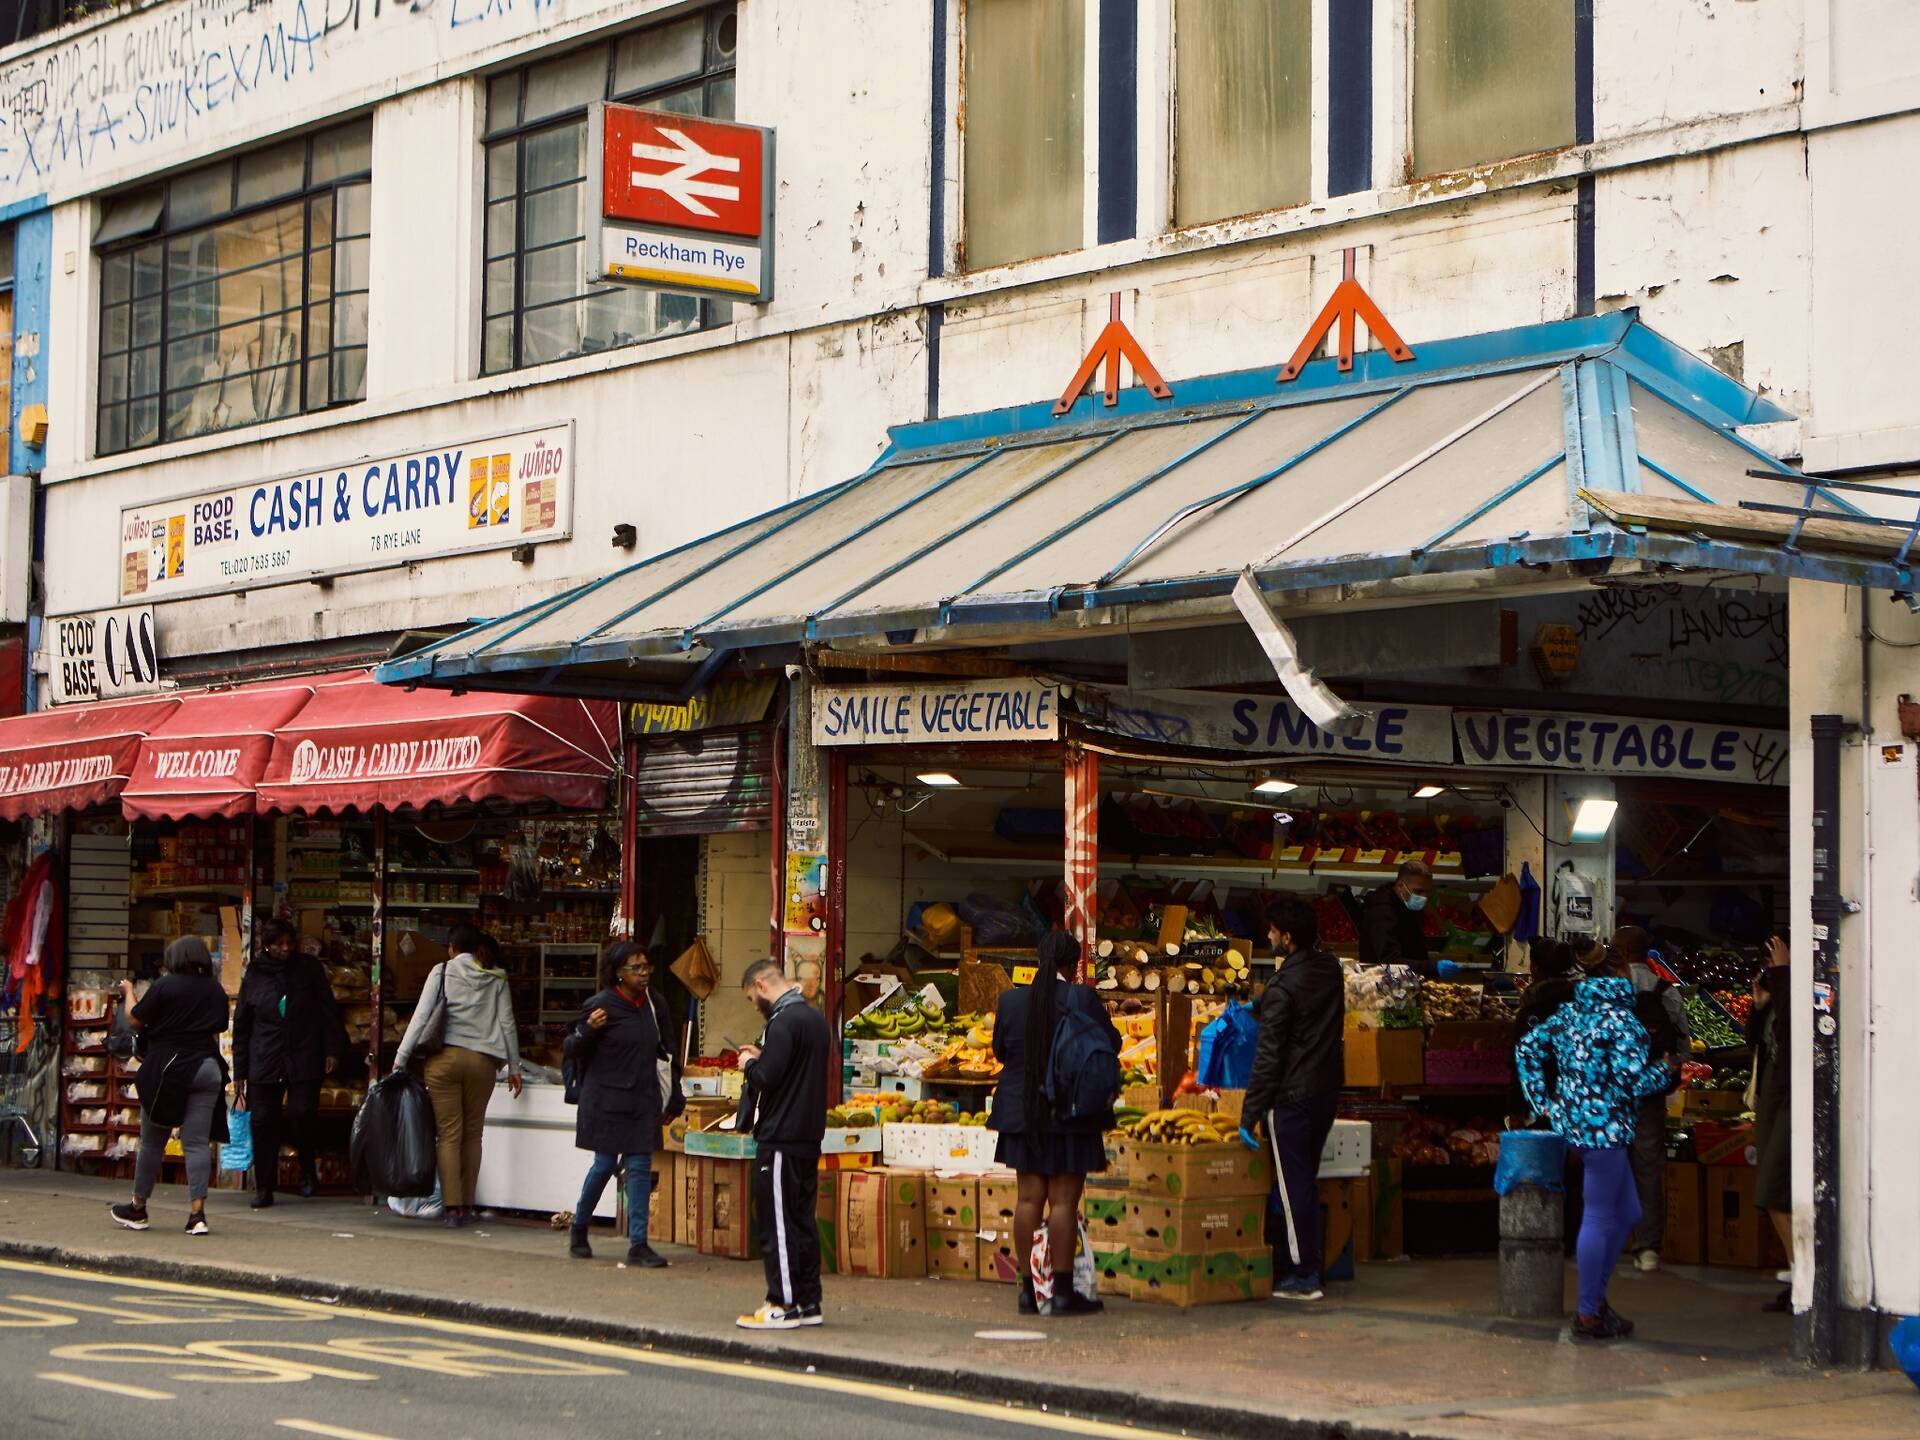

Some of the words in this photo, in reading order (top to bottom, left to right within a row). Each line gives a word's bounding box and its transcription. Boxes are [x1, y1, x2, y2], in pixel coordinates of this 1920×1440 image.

[626, 237, 706, 263] Peckham
[713, 249, 745, 272] Rye
[519, 447, 563, 479] JUMBO
[193, 496, 234, 524] FOOD
[250, 477, 324, 538] CASH
[333, 471, 352, 523] &
[362, 450, 463, 518] CARRY
[124, 519, 151, 542] JUMBO
[371, 535, 381, 551] 78
[383, 532, 399, 549] RYE
[401, 528, 421, 547] LANE
[250, 554, 269, 571] 7635
[272, 550, 291, 568] 5867
[60, 620, 94, 658] FOOD
[104, 612, 156, 688] CAS
[62, 659, 98, 696] BASE
[824, 695, 911, 736] SMILE
[921, 690, 1051, 733] VEGETABLE
[314, 746, 356, 780] CASH
[353, 745, 367, 776] &
[367, 741, 419, 776] CARRY
[416, 735, 482, 772] LIMITED
[1465, 716, 1741, 771] VEGETABLE
[18, 761, 62, 792] CARRY
[58, 755, 112, 786] LIMITED
[155, 749, 240, 778] WELCOME
